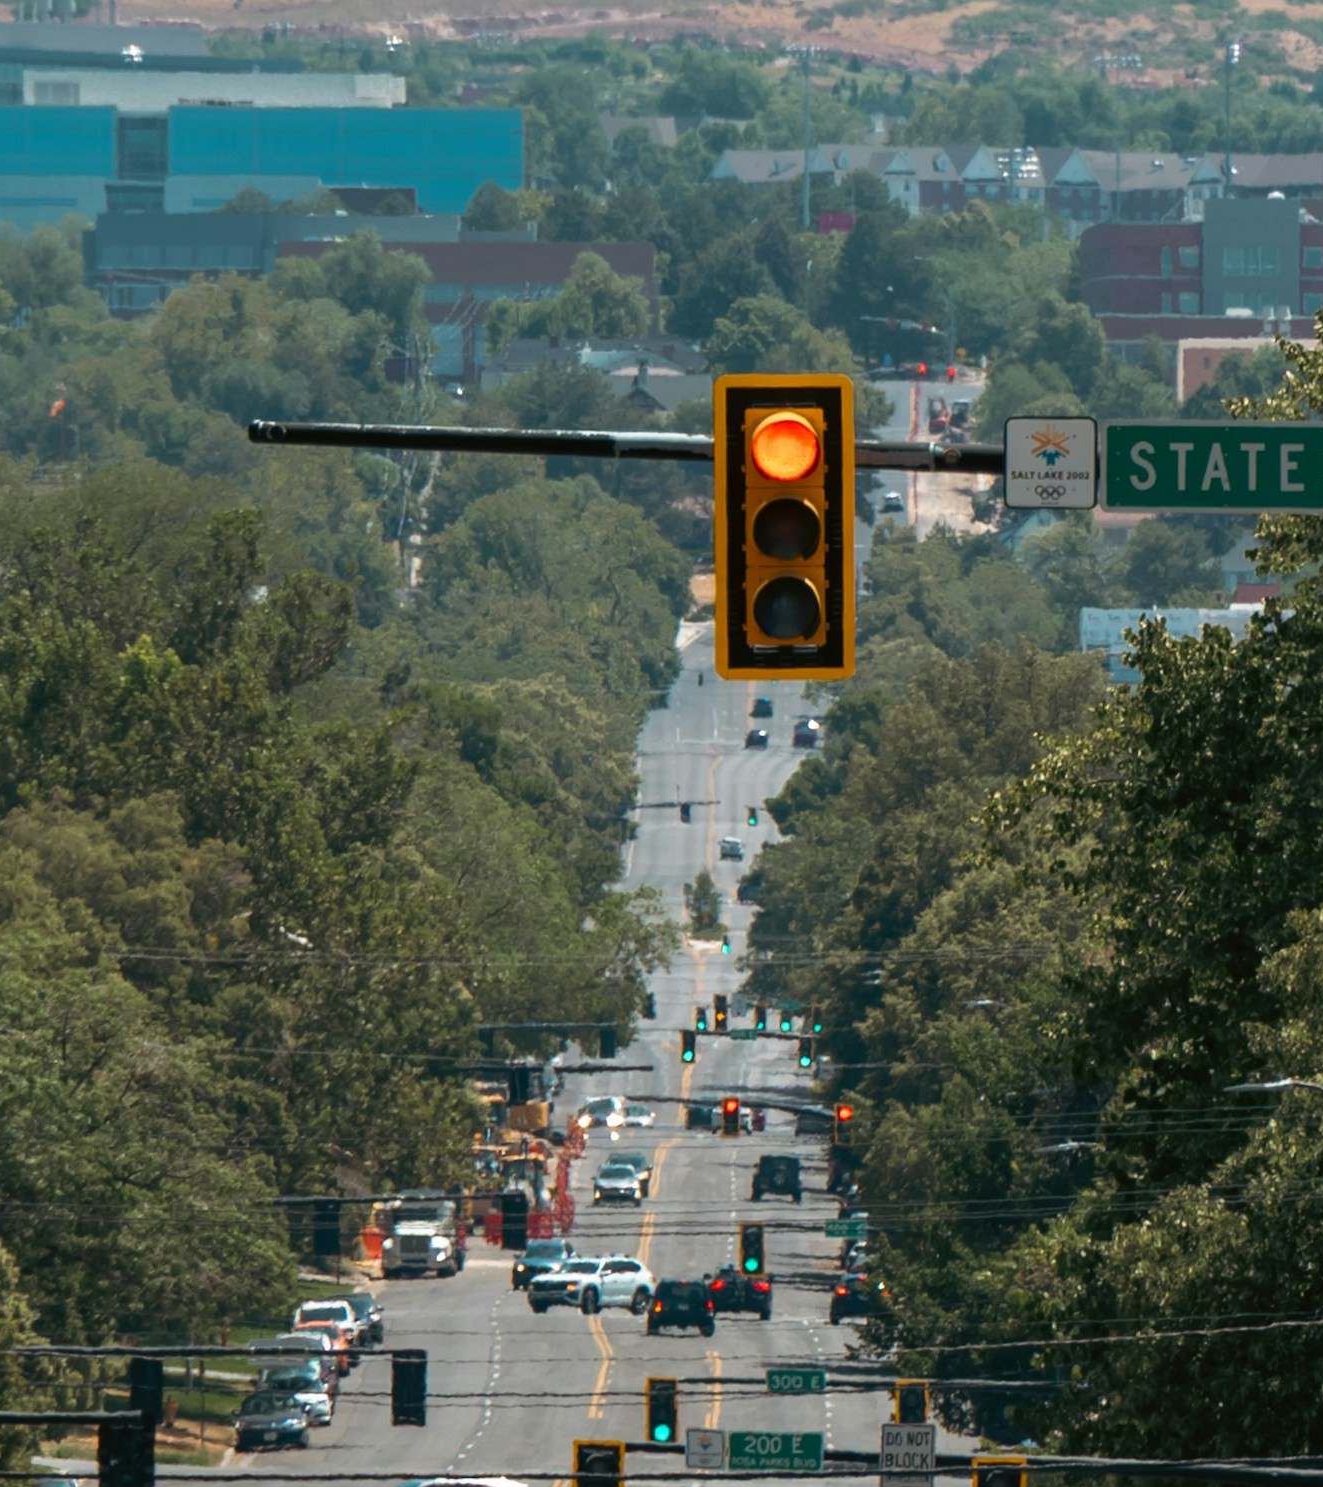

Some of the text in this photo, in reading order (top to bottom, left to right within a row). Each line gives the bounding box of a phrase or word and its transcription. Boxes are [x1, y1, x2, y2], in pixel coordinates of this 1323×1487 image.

[1129, 440, 1305, 492] STATE
[1011, 470, 1090, 480] SALT LAKE 2002
[771, 1375, 821, 1390] 300 E
[743, 1434, 804, 1454] 200 E
[885, 1431, 930, 1447] DO NOT
[758, 1456, 791, 1468] PARKS
[793, 1456, 817, 1468] BLVD
[884, 1452, 930, 1469] BLOCK
